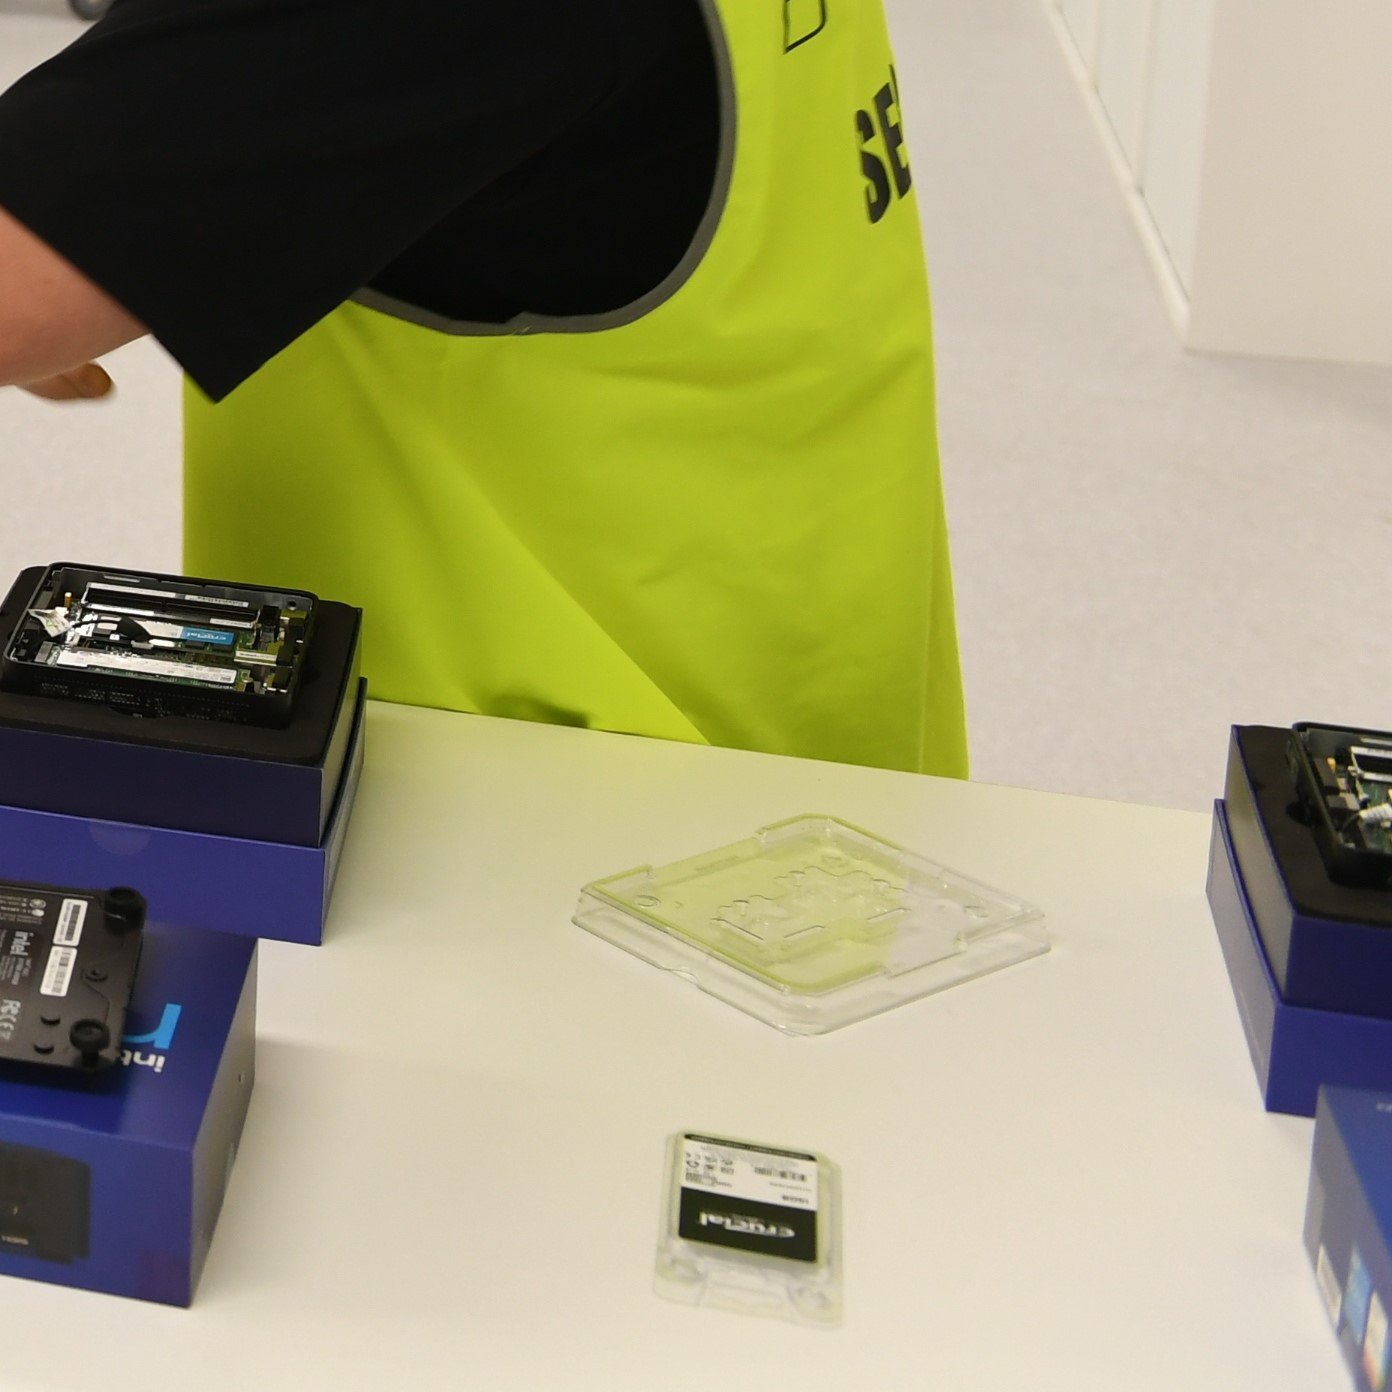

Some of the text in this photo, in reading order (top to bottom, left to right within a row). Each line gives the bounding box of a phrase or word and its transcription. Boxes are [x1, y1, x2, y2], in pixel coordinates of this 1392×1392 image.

[855, 64, 912, 224] SE
[10, 930, 35, 956] intel
[120, 1049, 166, 1073] int
[698, 1210, 796, 1238] crucial
